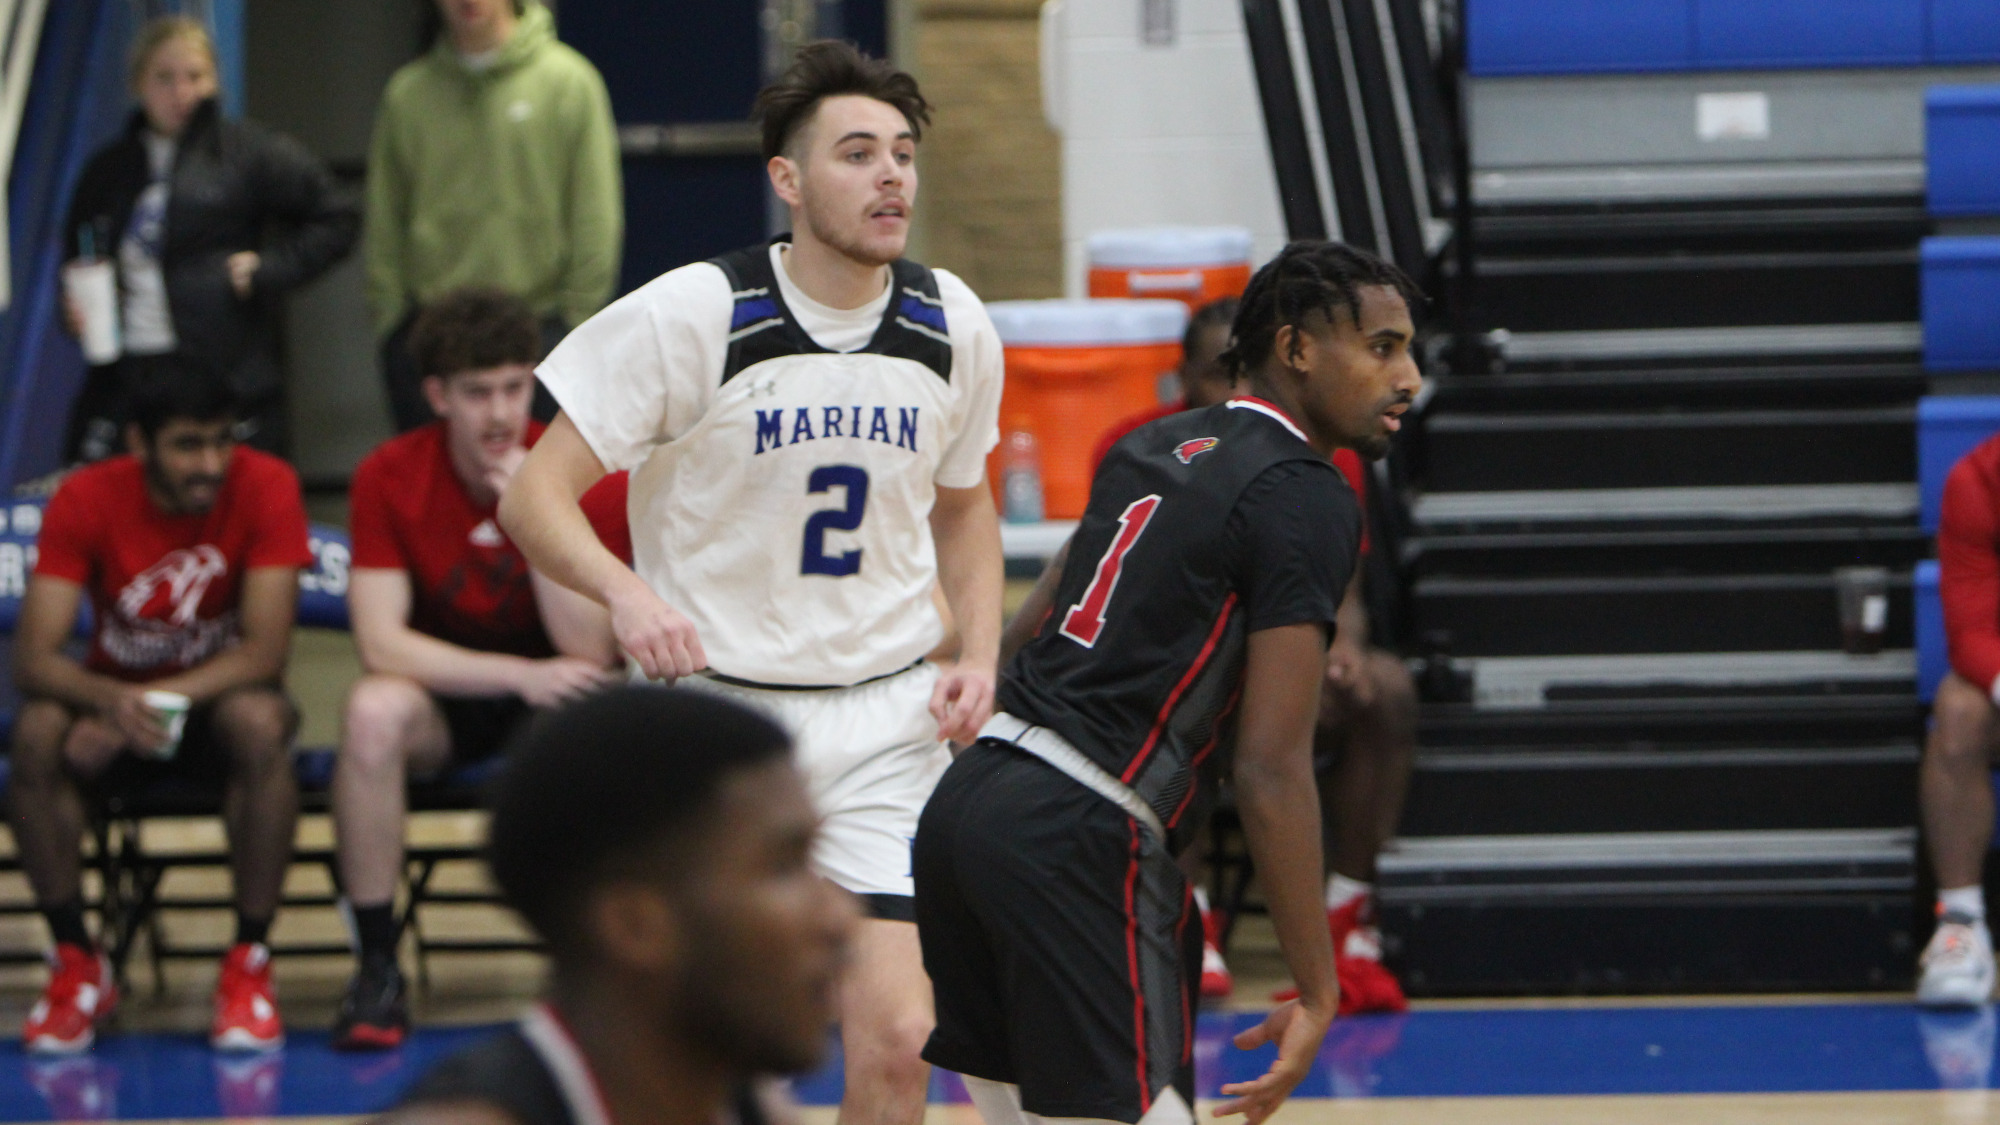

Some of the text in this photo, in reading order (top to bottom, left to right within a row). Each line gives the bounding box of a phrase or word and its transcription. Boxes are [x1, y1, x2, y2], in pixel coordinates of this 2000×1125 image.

[754, 406, 919, 454] MARIAN
[801, 463, 869, 577] 2
[1058, 494, 1162, 648] 1
